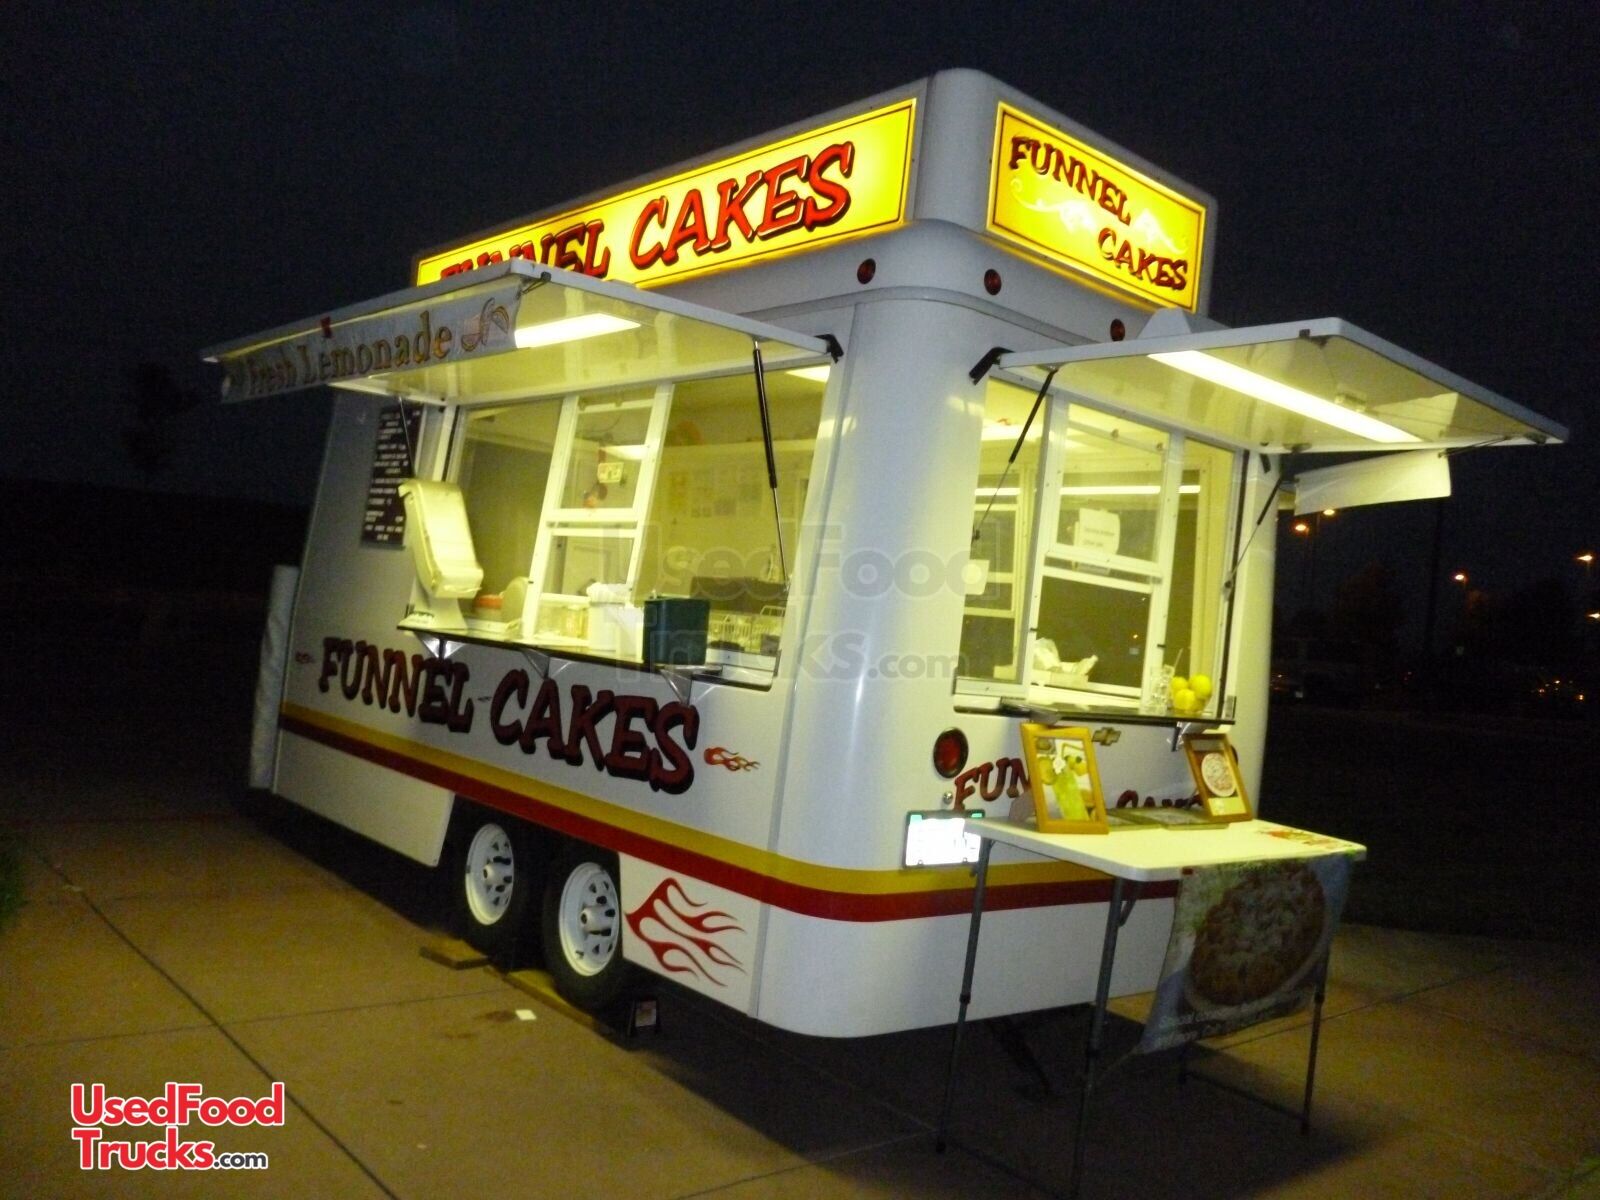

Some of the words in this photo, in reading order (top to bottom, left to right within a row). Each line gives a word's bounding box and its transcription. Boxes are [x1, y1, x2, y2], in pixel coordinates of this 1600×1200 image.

[441, 218, 611, 279] NEL
[628, 141, 855, 269] CAKES
[1008, 135, 1131, 226] FUNNEL
[1098, 228, 1187, 290] CAKES
[297, 310, 452, 384] Lemonade
[318, 636, 474, 733] FUNNEL
[490, 668, 701, 794] CAKES
